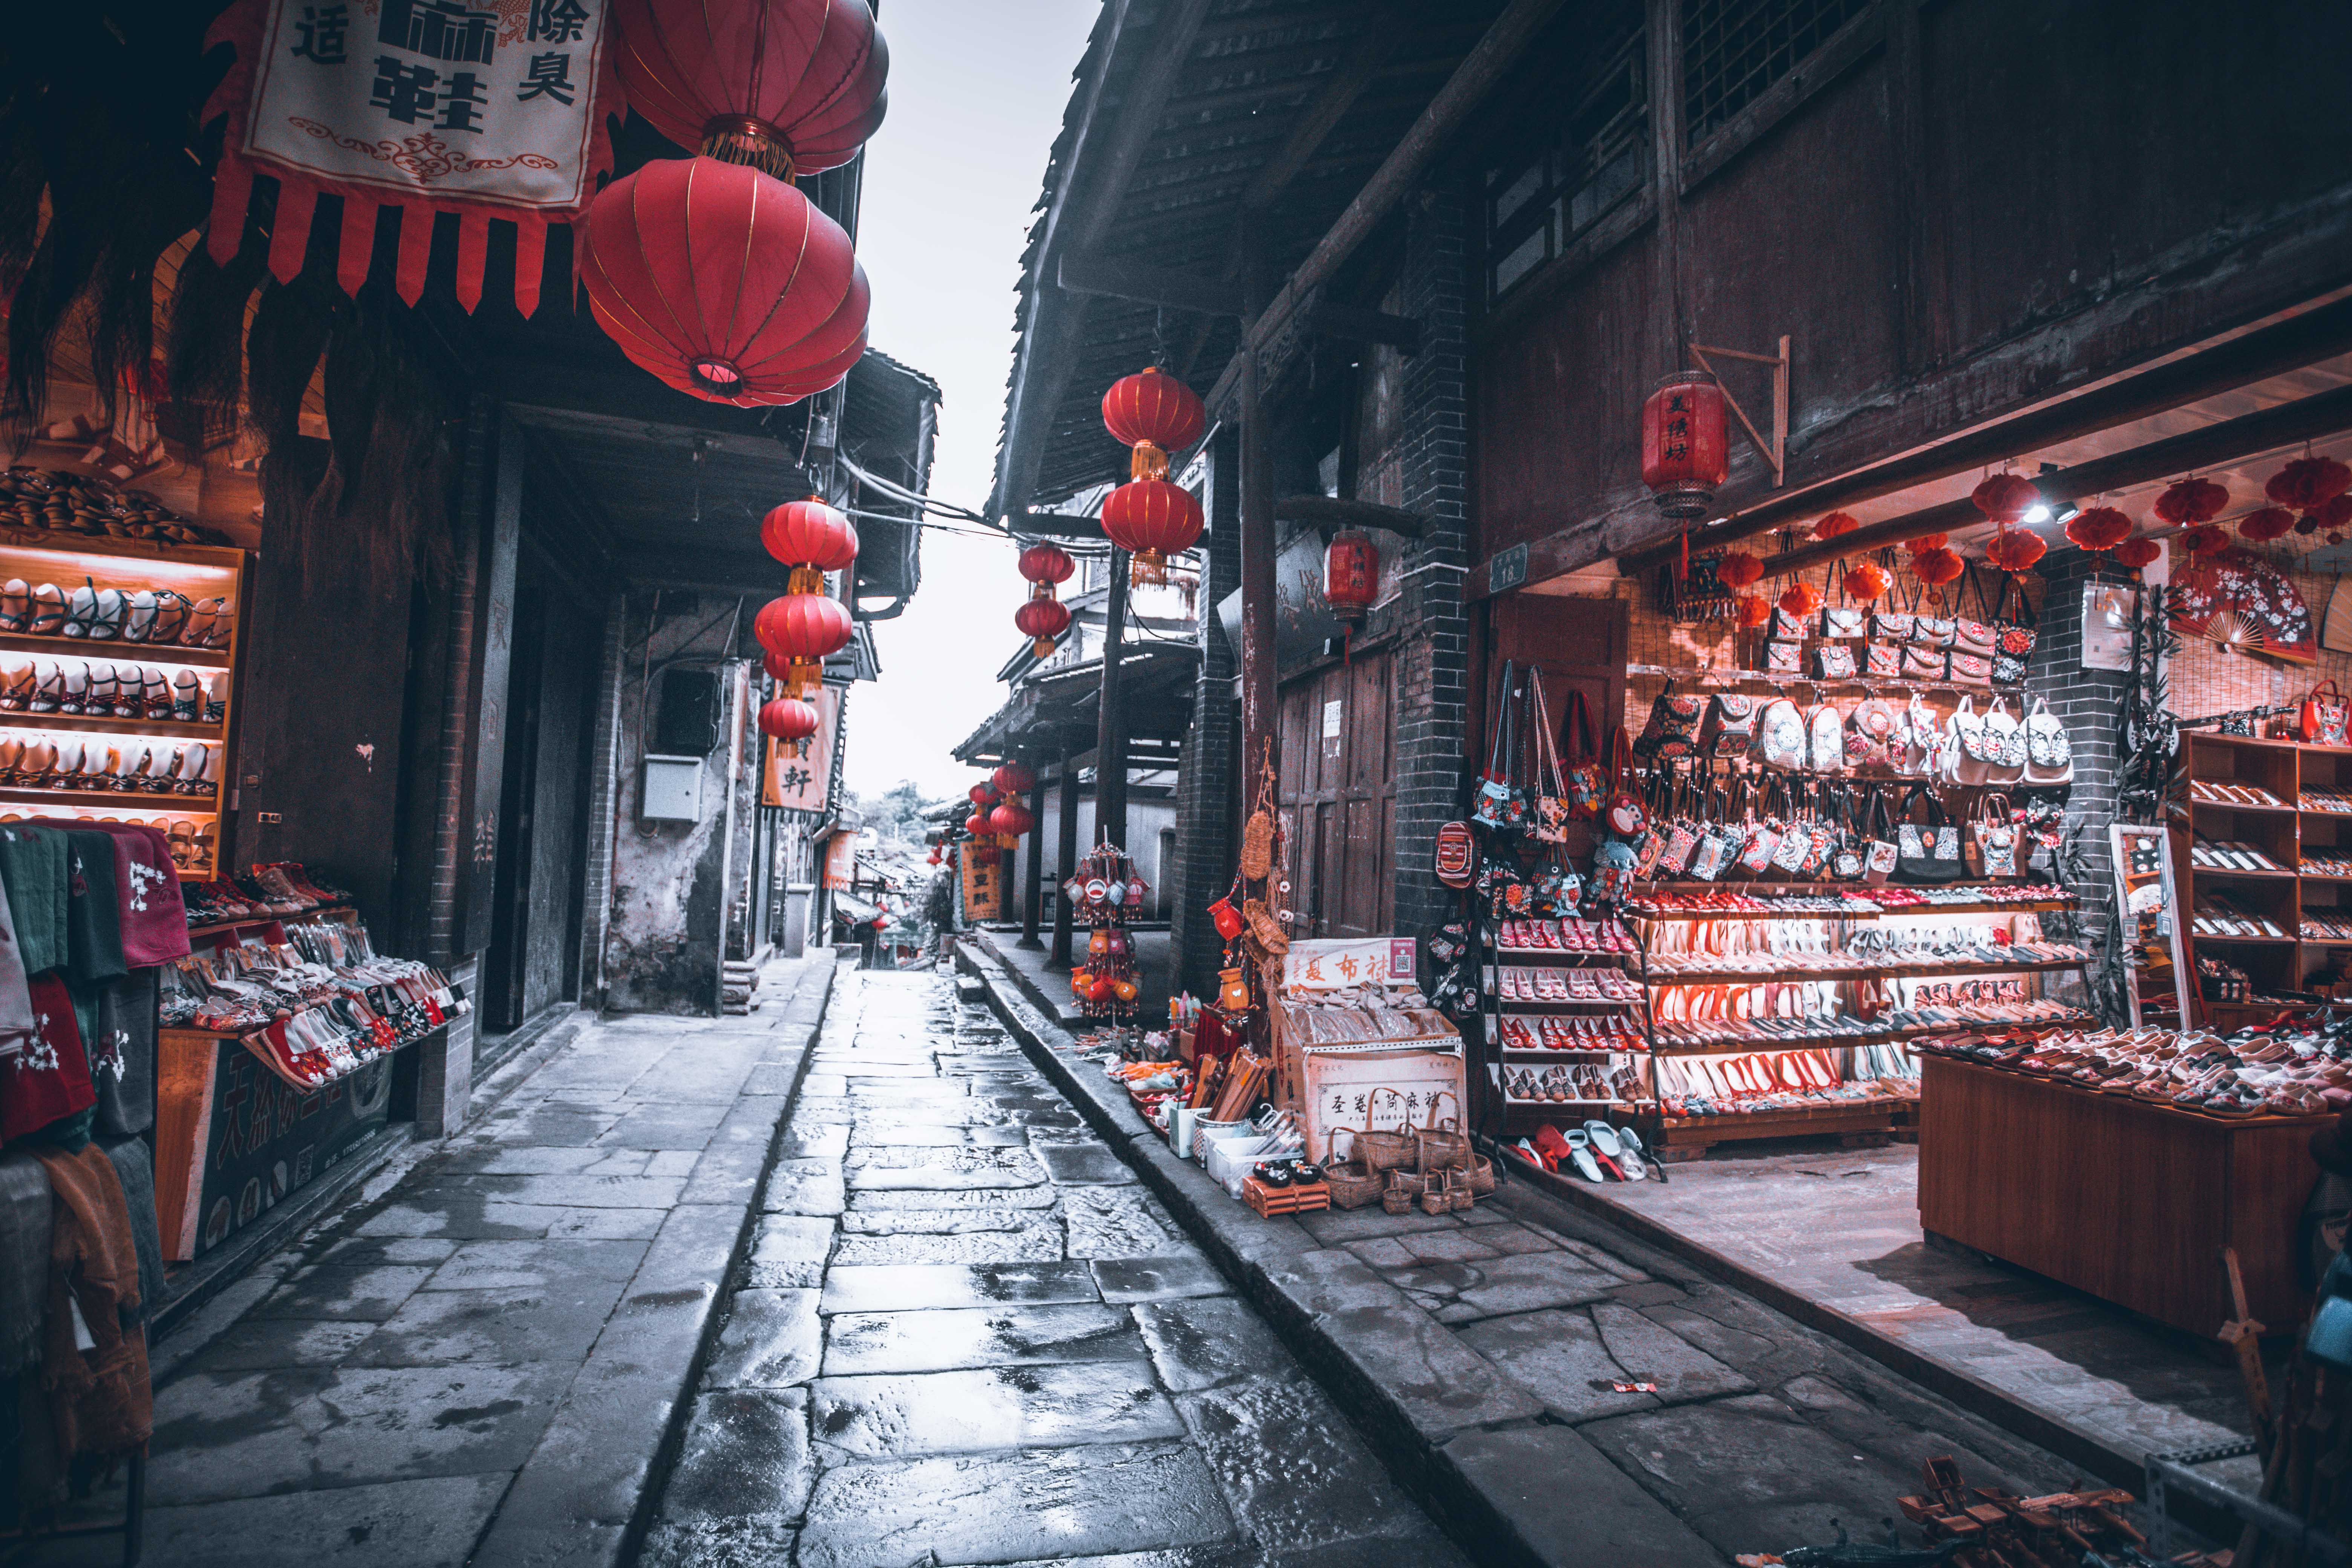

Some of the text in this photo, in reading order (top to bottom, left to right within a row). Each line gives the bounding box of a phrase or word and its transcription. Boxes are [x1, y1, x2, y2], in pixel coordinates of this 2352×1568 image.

[290, 3, 349, 65] 适
[516, 0, 591, 107] 除臭
[1502, 565, 1514, 584] 18
